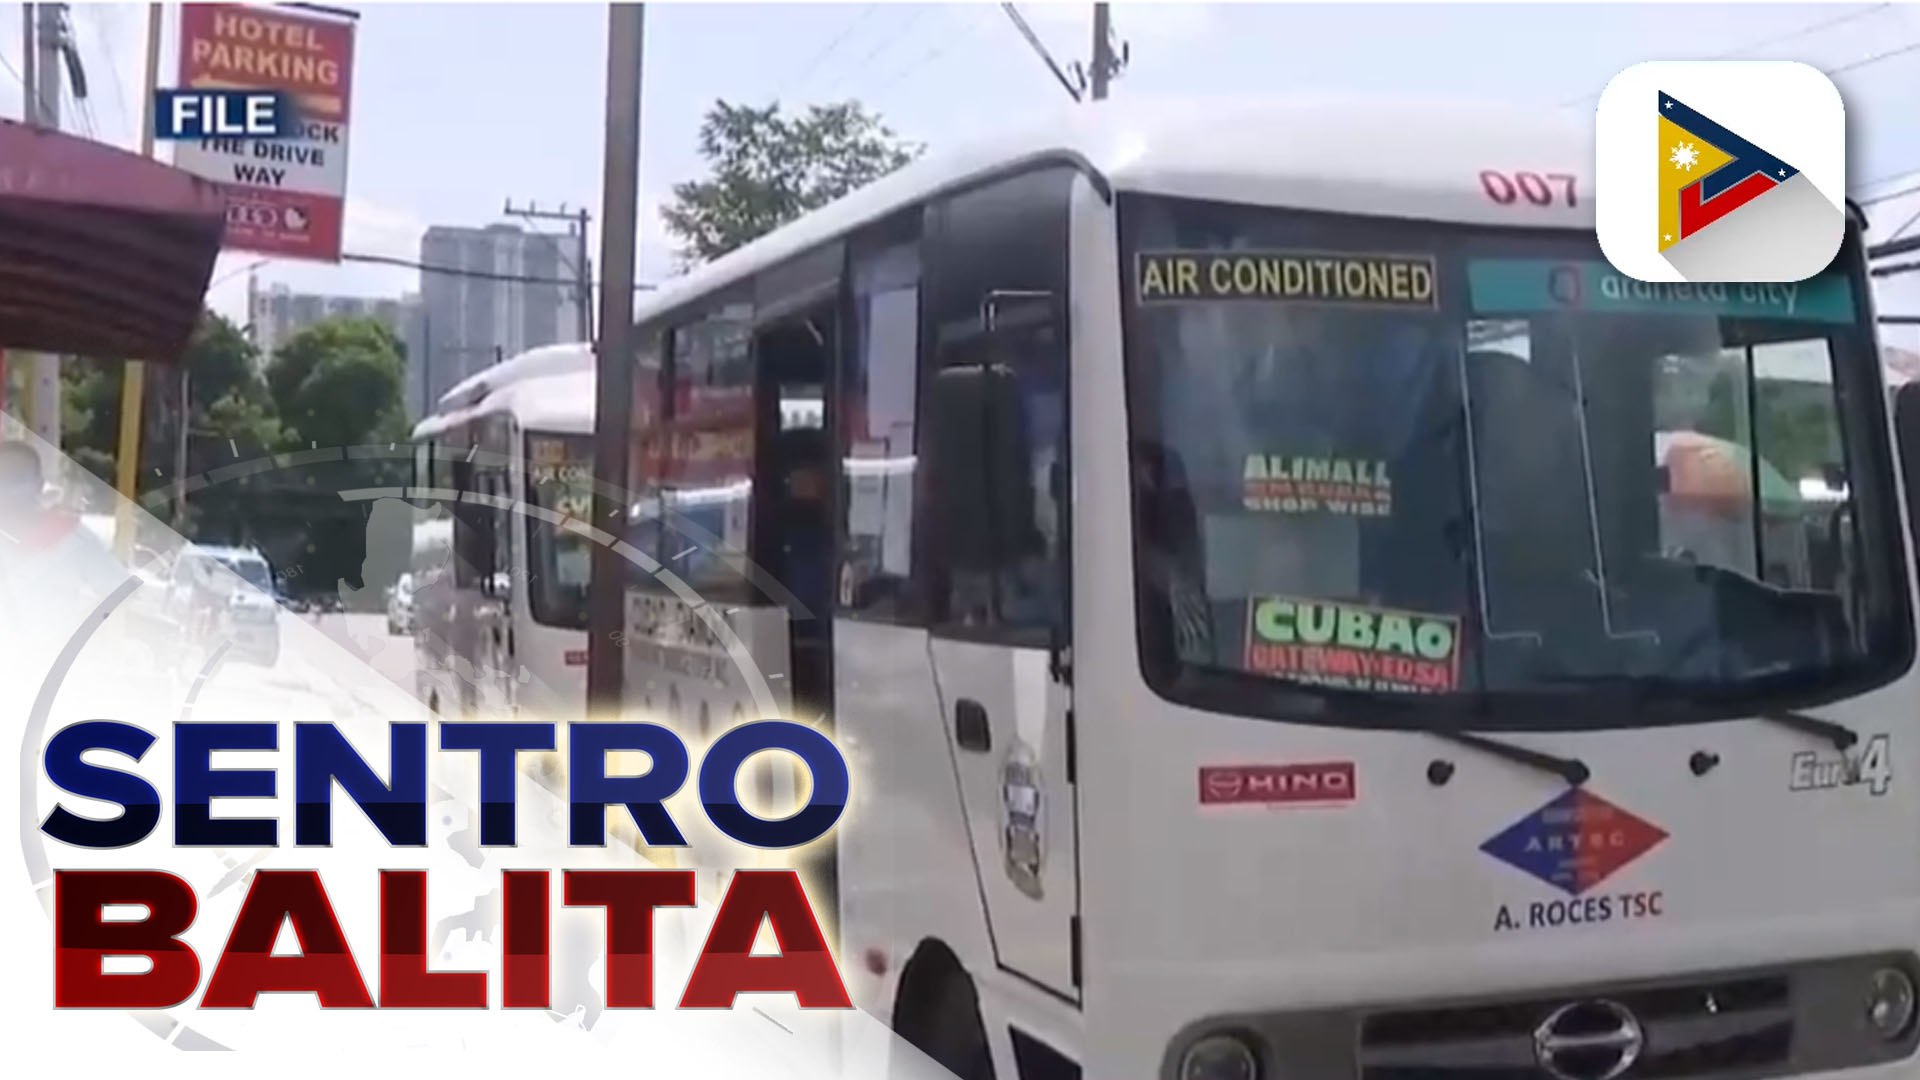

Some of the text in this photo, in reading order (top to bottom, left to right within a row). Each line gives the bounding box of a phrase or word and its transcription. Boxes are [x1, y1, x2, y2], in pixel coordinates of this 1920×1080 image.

[214, 12, 324, 50] HOTEL
[191, 37, 339, 84] PARKING
[253, 141, 325, 167] DRIVE
[233, 163, 286, 186] WAY
[1479, 169, 1577, 208] 007
[1142, 257, 1432, 299] AIR CONDITIONED
[1255, 600, 1453, 660] CUBAO
[1248, 772, 1348, 793] HINO
[1493, 892, 1664, 932] A. ROCES TSC
